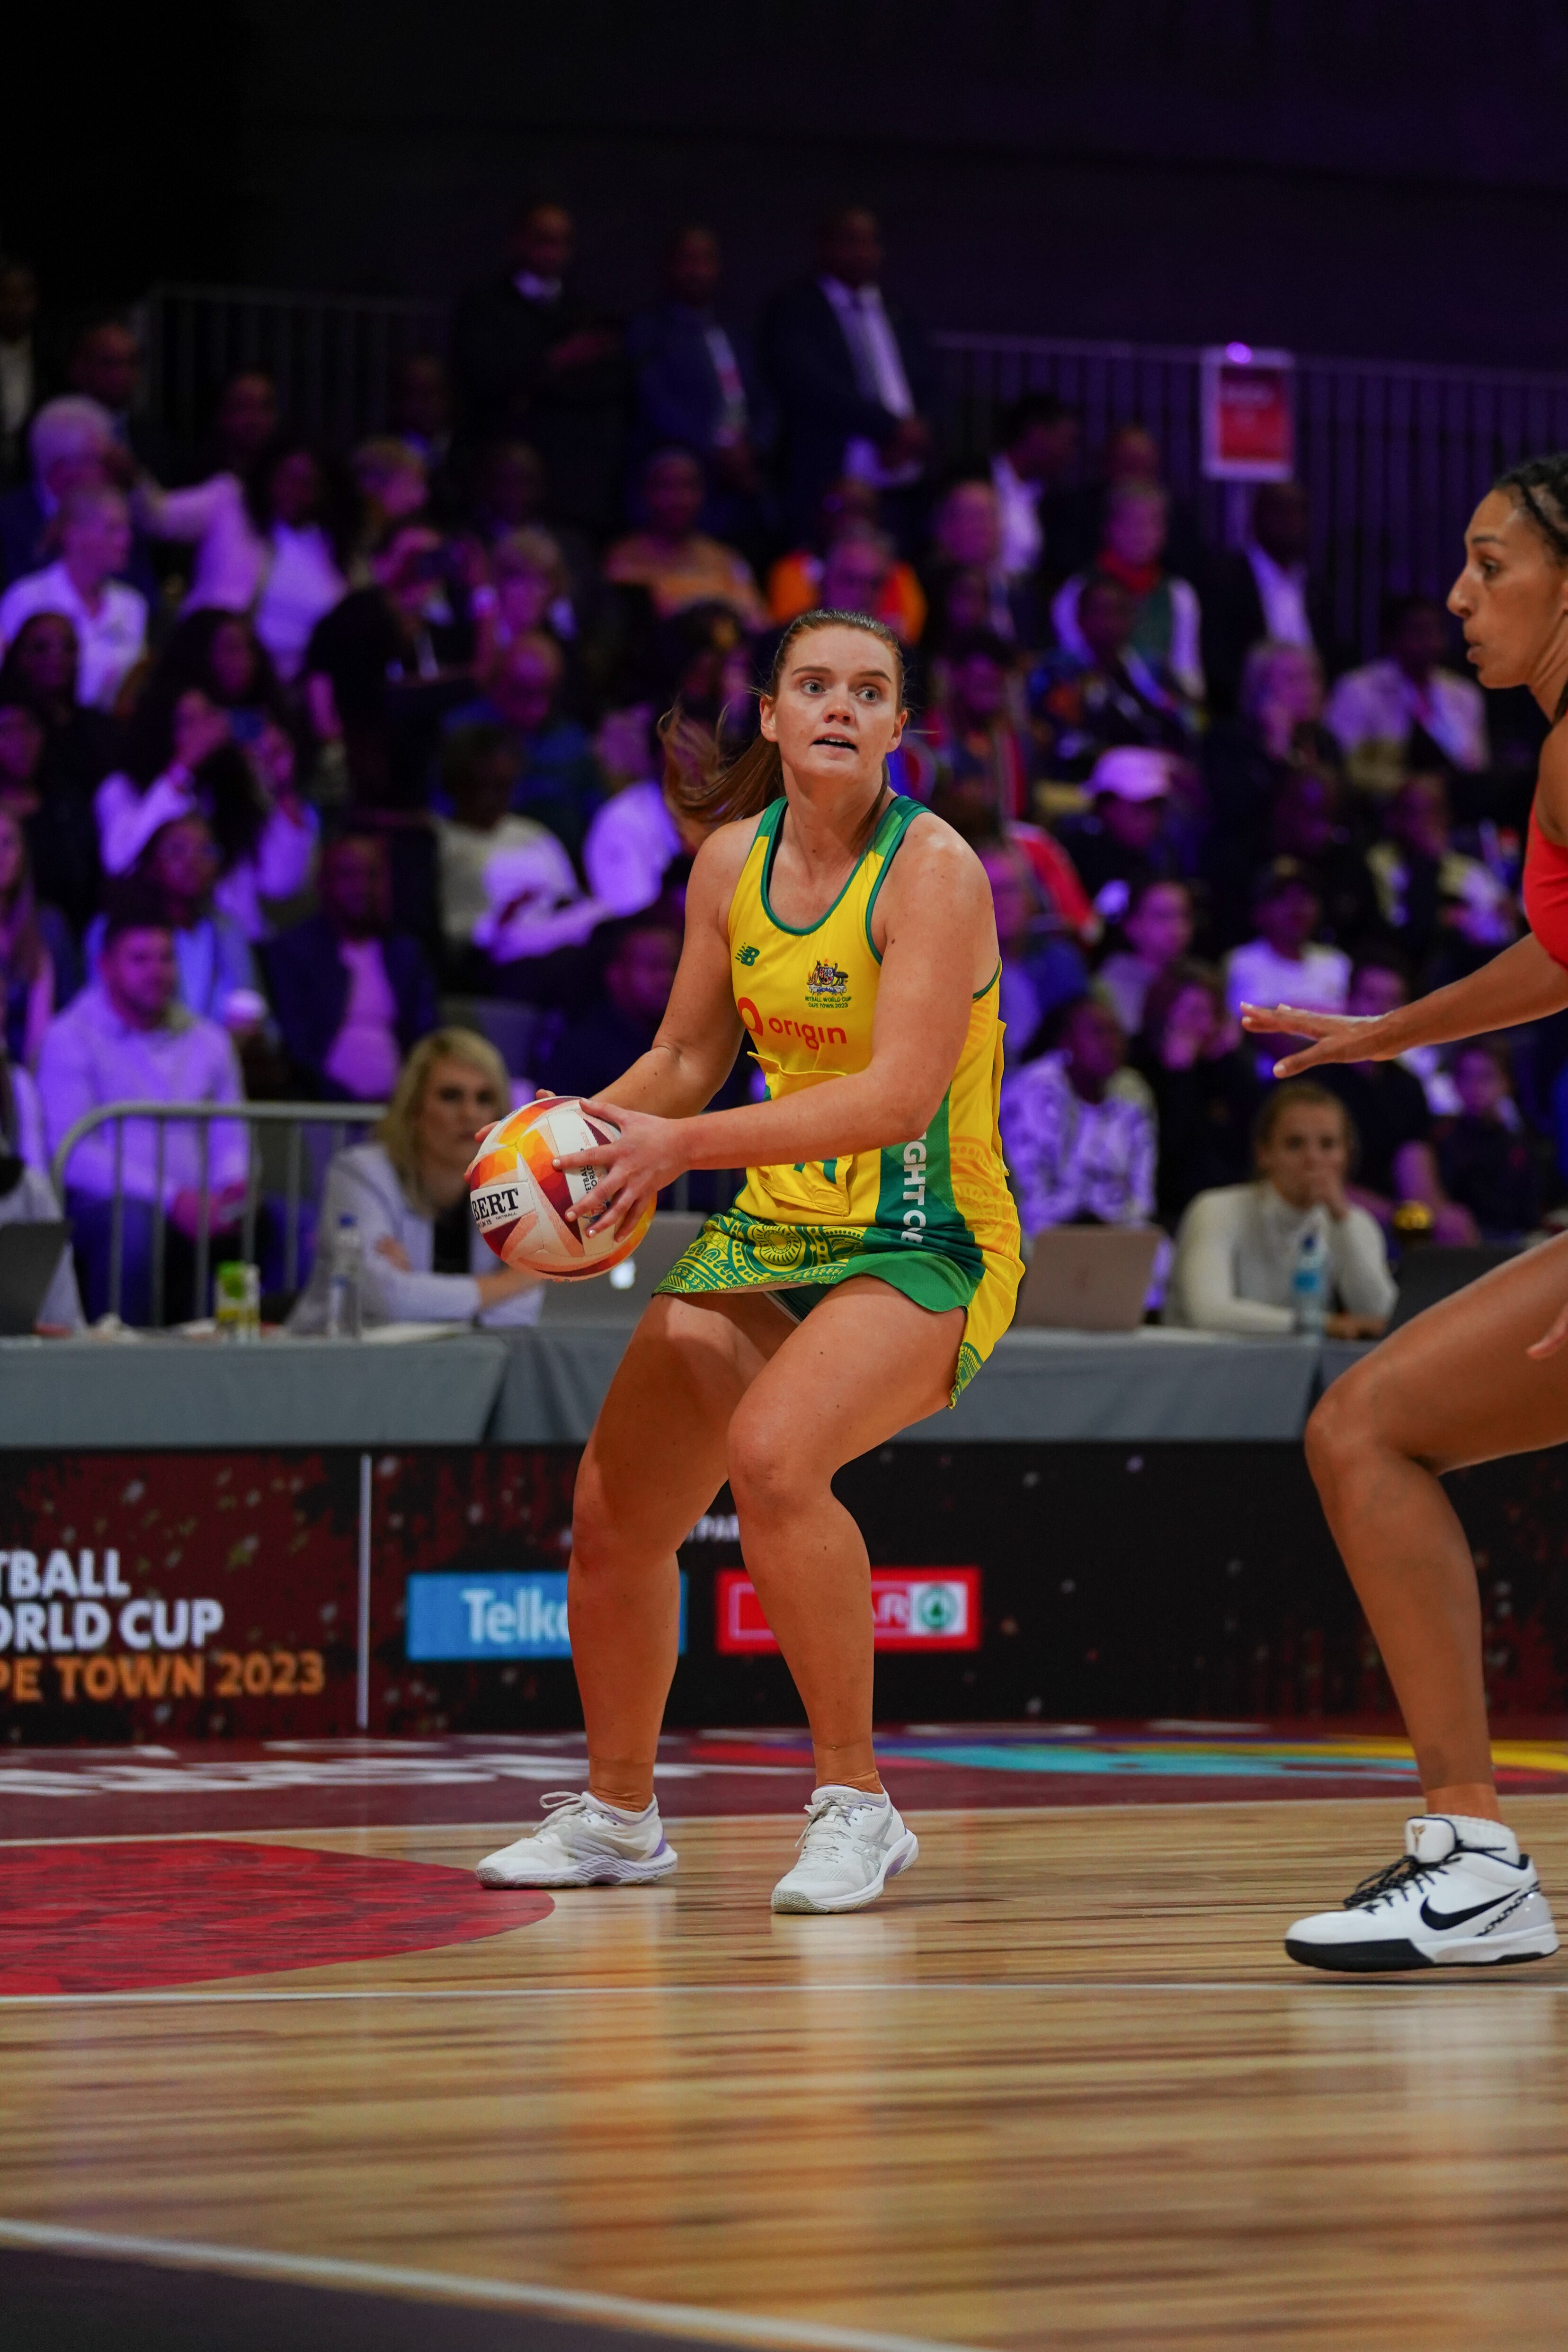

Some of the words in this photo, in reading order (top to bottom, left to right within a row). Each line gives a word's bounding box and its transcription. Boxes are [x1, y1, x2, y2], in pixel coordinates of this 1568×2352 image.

[768, 1017, 847, 1051] origin
[118, 1598, 224, 1650] CUP
[53, 1653, 205, 1702] TOWN
[216, 1650, 325, 1696] 2023
